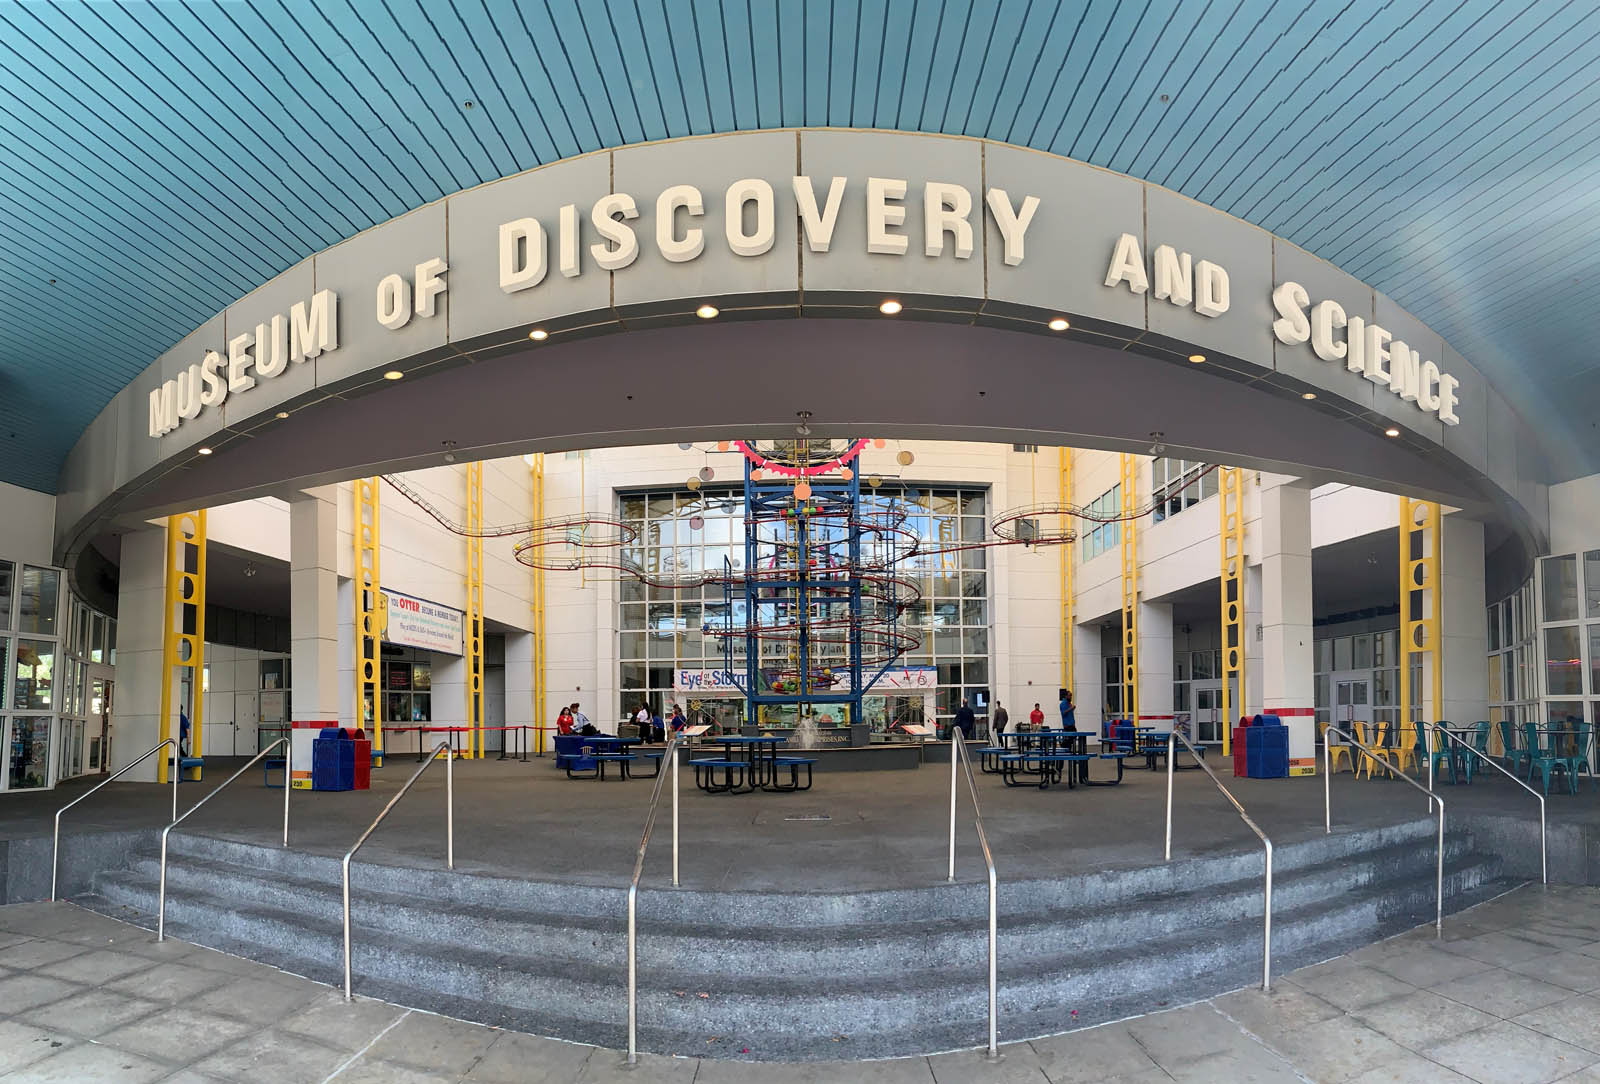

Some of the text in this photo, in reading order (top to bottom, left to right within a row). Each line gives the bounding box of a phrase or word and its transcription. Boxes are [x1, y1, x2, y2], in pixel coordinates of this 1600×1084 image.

[150, 175, 1460, 438] MUSEUM OF DISCOVERY AND SCIENCE
[400, 598, 420, 612] OTTER
[763, 644, 771, 654] of
[680, 671, 703, 690] Eye
